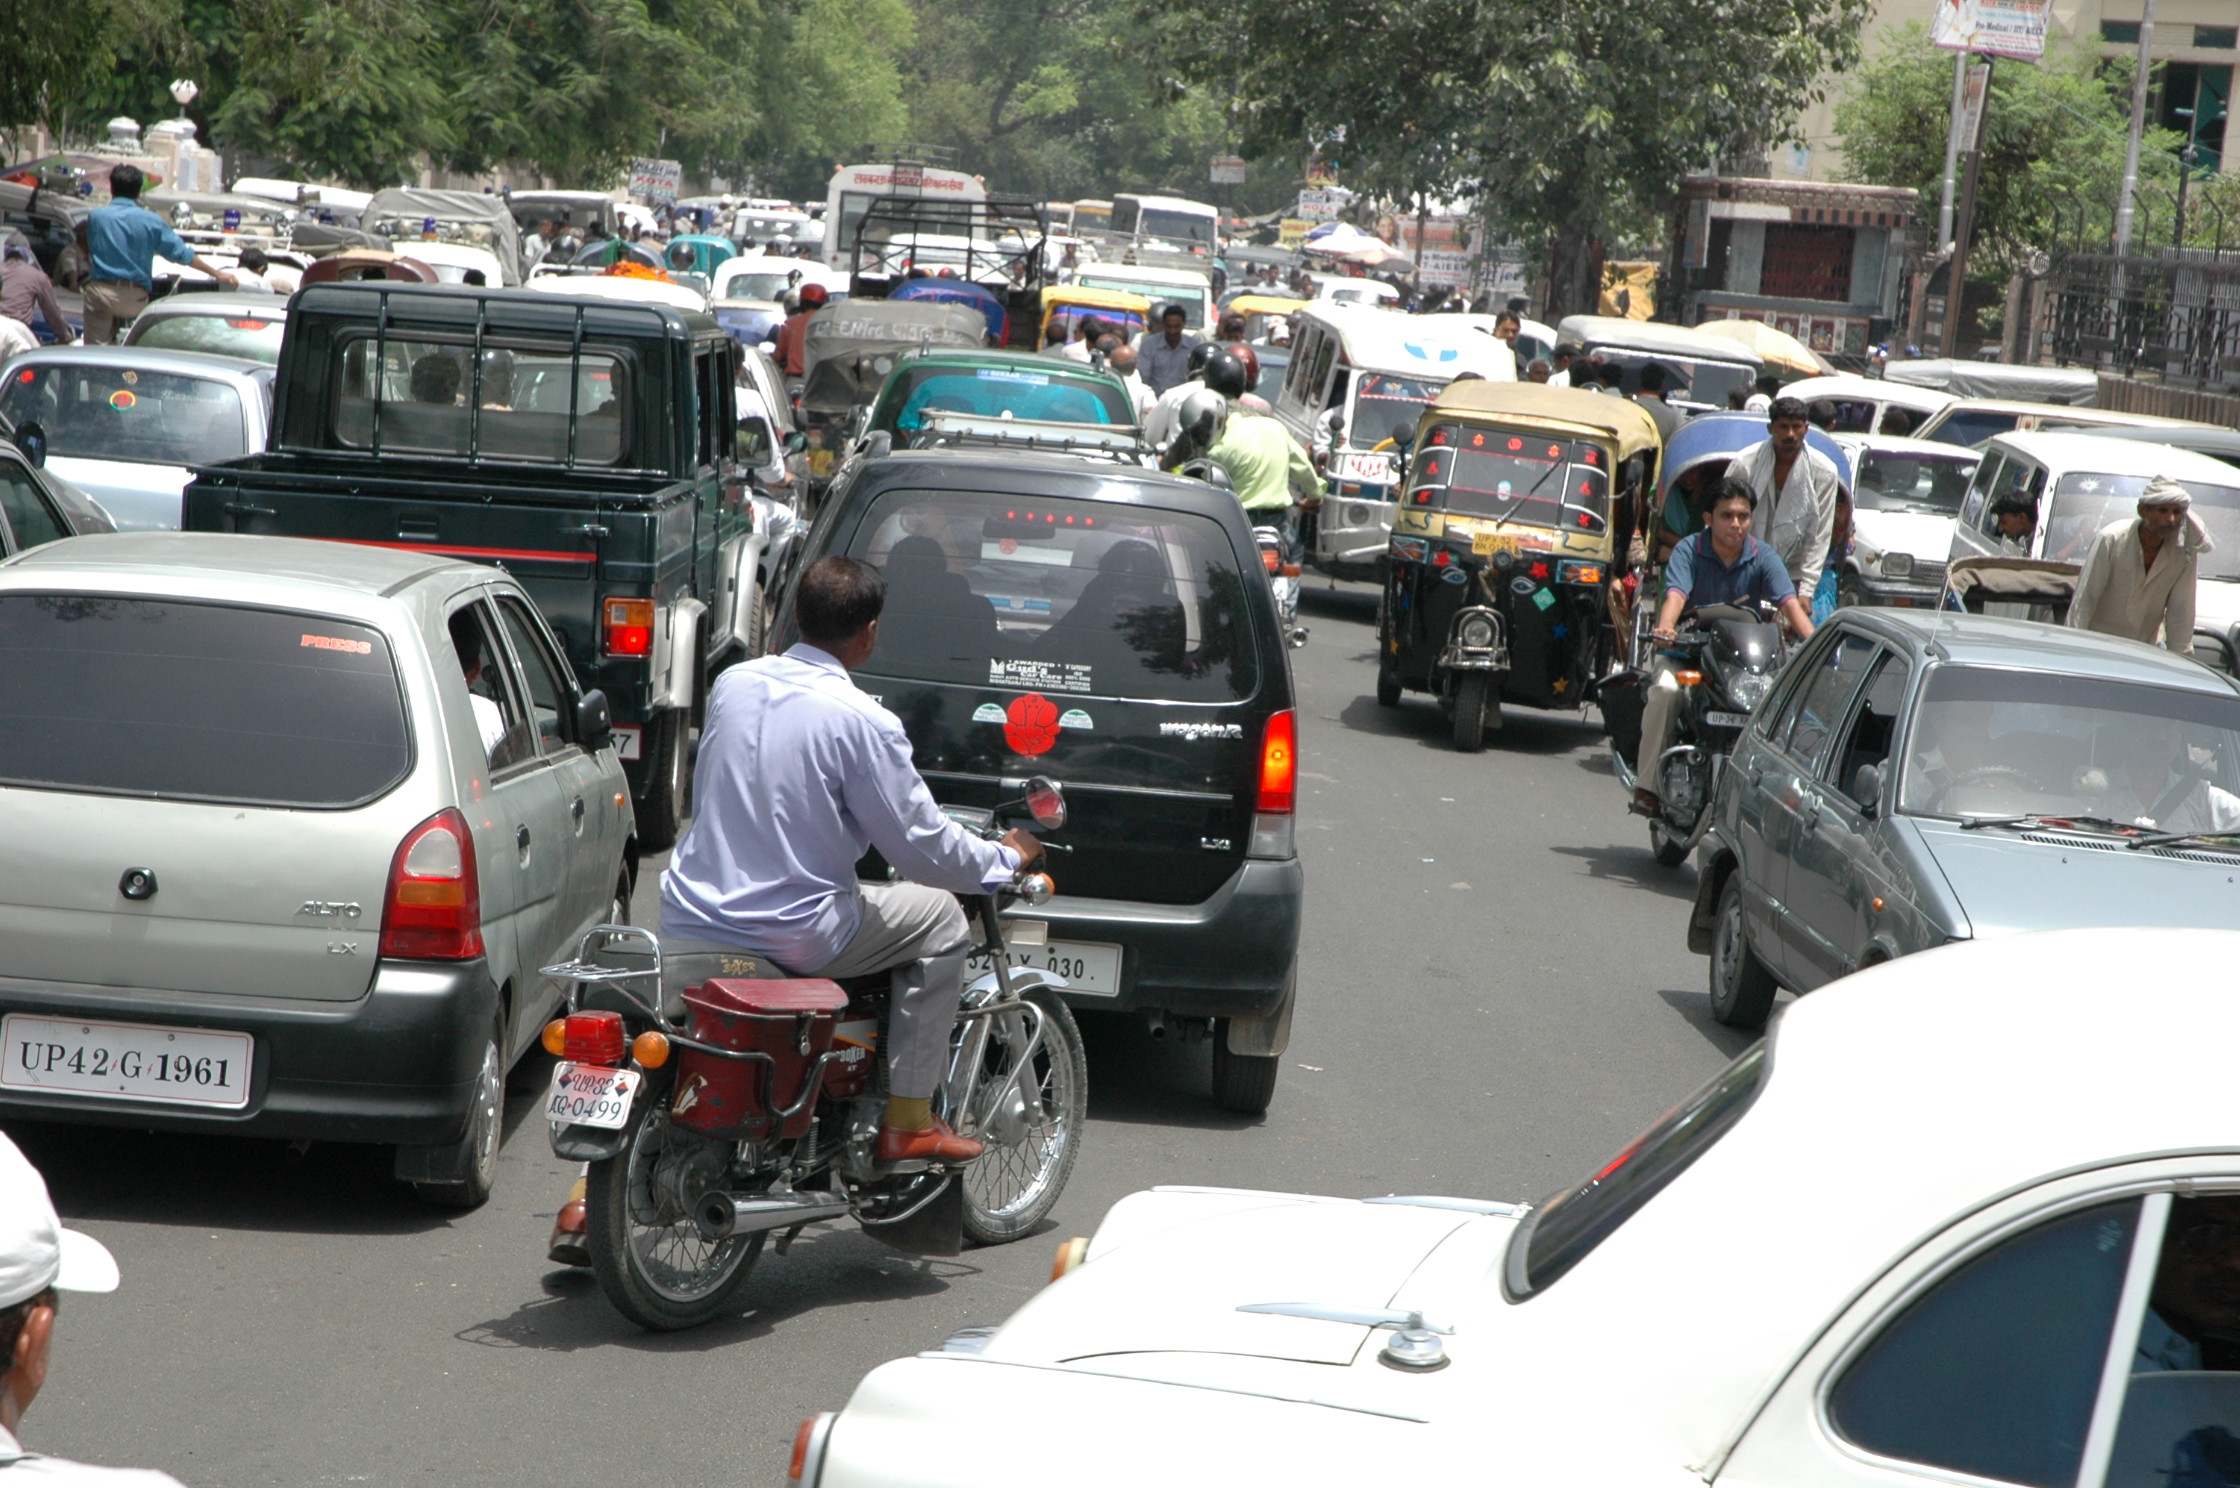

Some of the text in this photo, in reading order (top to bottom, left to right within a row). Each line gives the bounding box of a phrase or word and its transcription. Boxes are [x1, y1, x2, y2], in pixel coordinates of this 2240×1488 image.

[636, 175, 674, 187] KOTA
[301, 634, 371, 654] PRESS
[1005, 663, 1048, 675] Gud's
[1014, 660, 1056, 668] AWARDED
[1040, 672, 1063, 680] Care
[294, 900, 362, 918] ALTO
[327, 941, 357, 955] LX
[722, 959, 756, 976] BOXER
[21, 1041, 231, 1088] UP42 G 1961
[572, 1097, 622, 1121] 0499
